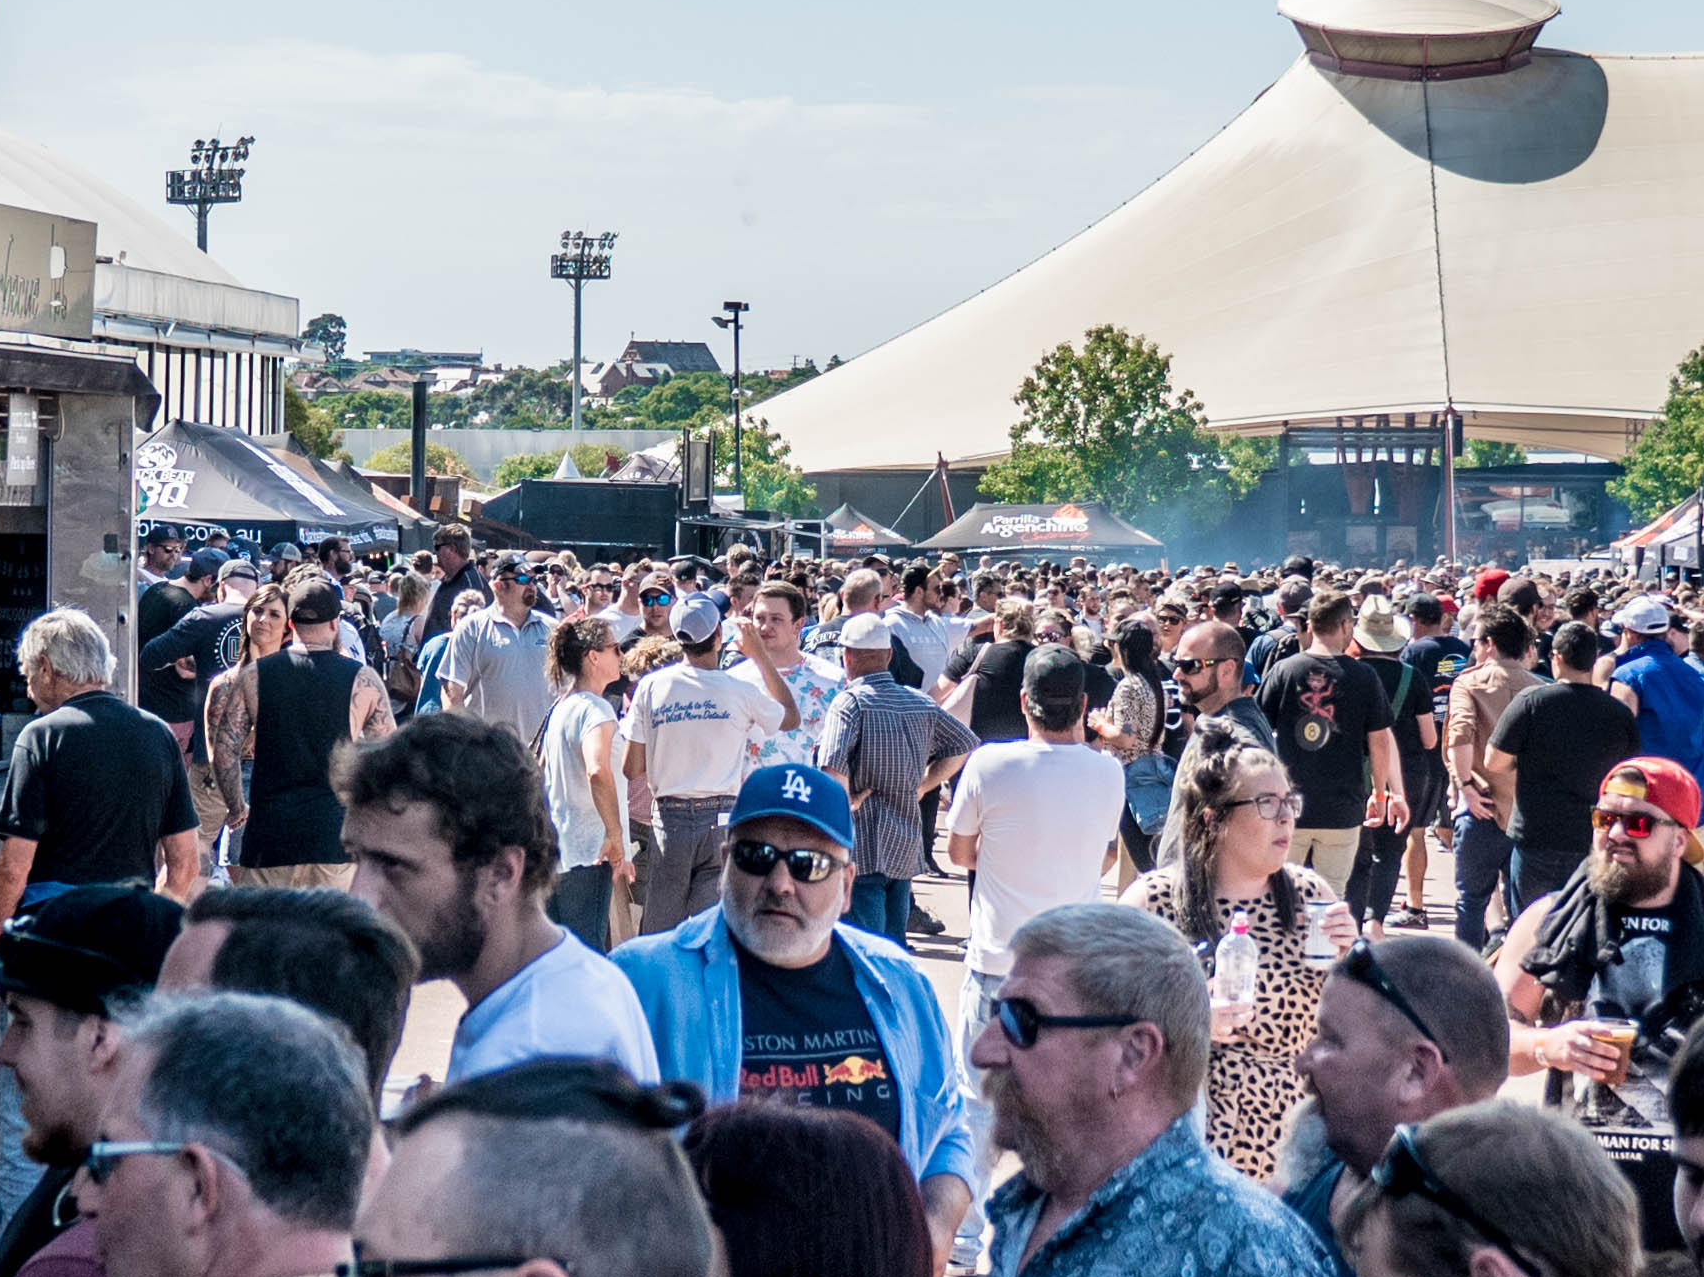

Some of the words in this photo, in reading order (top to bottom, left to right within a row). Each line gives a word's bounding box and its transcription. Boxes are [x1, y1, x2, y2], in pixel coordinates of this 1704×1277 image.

[161, 471, 195, 485] BEAR
[992, 513, 1040, 526] Parrilla
[980, 520, 1089, 538] Argenchino
[780, 769, 813, 803] LA
[1640, 918, 1671, 932] FOR
[742, 1034, 797, 1051] STON
[803, 1029, 877, 1050] MARTIN
[1632, 1137, 1659, 1151] FOR
